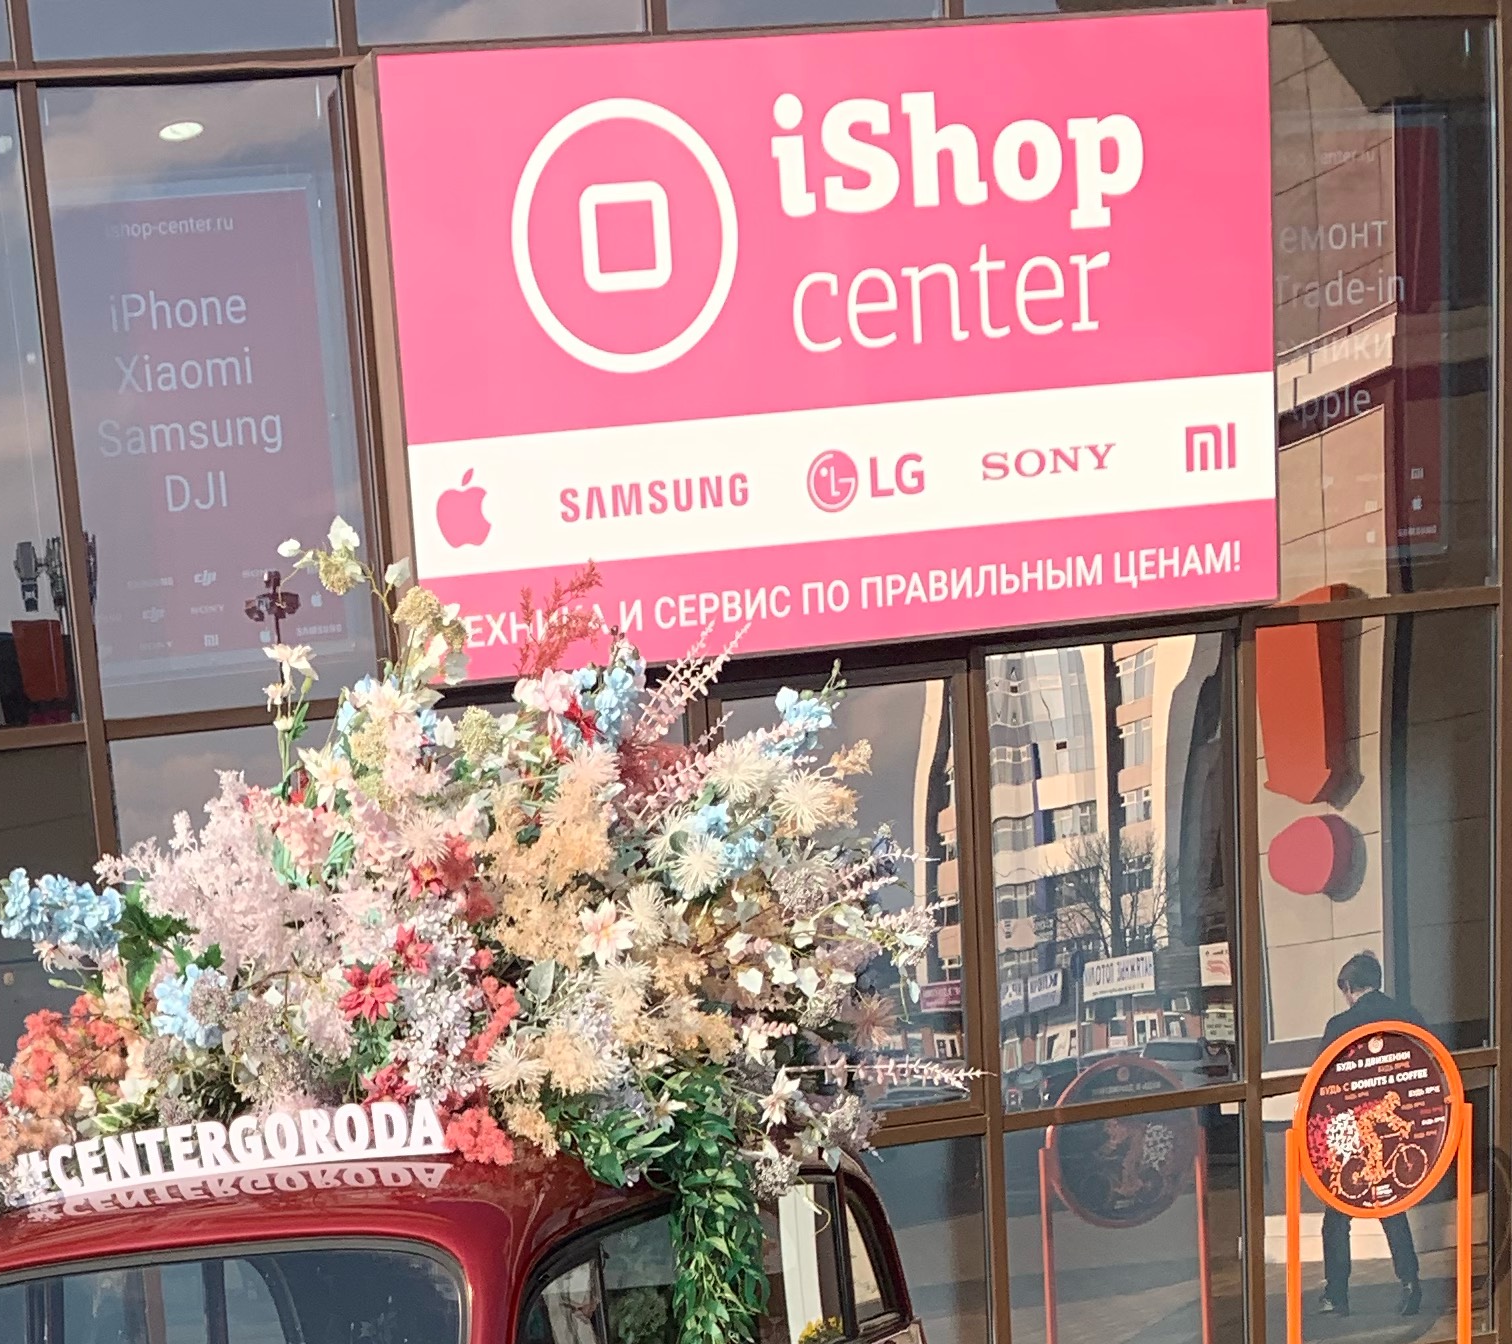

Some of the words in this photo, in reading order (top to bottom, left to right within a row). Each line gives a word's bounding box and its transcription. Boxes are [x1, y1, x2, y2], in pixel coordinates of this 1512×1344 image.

[771, 90, 1145, 232] iShop
[1278, 219, 1389, 254] емонт
[110, 289, 247, 332] iPhone
[792, 241, 1112, 355] center
[1276, 269, 1406, 311] Trade-in
[114, 346, 255, 395] Xiaomi
[97, 409, 284, 459] Samsung
[163, 469, 228, 513] DJI
[559, 471, 750, 524] SAMSUNG
[870, 451, 926, 499] LG
[981, 441, 1117, 482] SONY
[619, 599, 643, 633] И
[653, 589, 792, 632] СЕРВИС
[801, 577, 851, 614] ПО
[859, 551, 1105, 611] ПРАВИЛЬНЫМ
[1112, 540, 1242, 593] ЦЕНАМ!
[1319, 1085, 1342, 1097] БУДЬ
[1350, 1075, 1388, 1091] DONUTS
[1388, 1074, 1395, 1083] &
[1395, 1068, 1429, 1083] COFFEE
[1335, 1062, 1357, 1073] БУДЬ
[1357, 1058, 1364, 1068] В
[1364, 1051, 1411, 1067] ДВИЖЕНИИ
[14, 1099, 448, 1203] #CENTERGORODA
